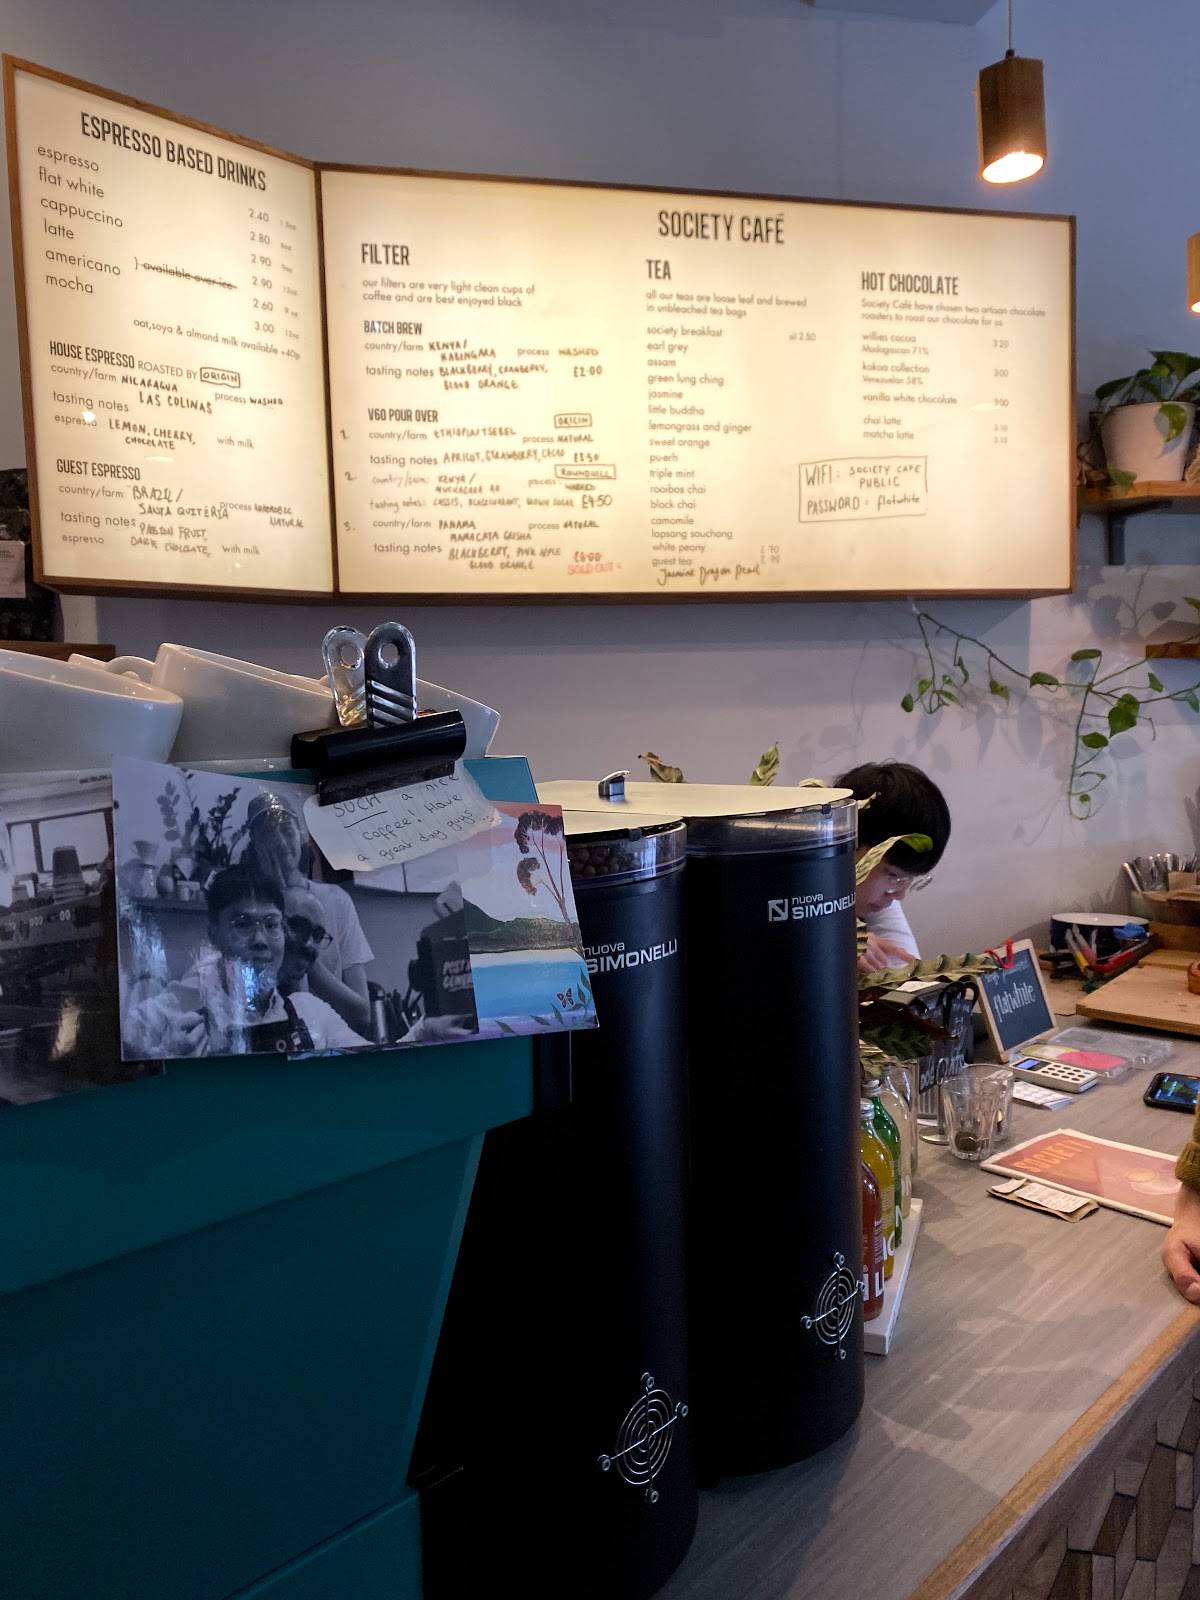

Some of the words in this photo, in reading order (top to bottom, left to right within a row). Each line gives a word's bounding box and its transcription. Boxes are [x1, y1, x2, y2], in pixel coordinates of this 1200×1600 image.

[81, 111, 161, 157] ESPRESSO
[166, 140, 213, 174] BASED
[218, 158, 266, 191] DRINKS
[37, 145, 99, 172] espresso
[39, 166, 61, 187] flat
[66, 174, 104, 198] white
[40, 197, 123, 228] cappuccino
[44, 218, 74, 239] latte
[658, 210, 734, 241] SOCIETY
[741, 213, 784, 244] CAFÉ
[361, 242, 410, 266] FILTER
[46, 249, 121, 276] americano
[646, 258, 671, 280] TEA
[143, 261, 192, 279] available
[46, 274, 93, 294] mocha
[362, 279, 378, 288] our
[381, 277, 406, 289] filters
[409, 282, 425, 291] are
[428, 282, 449, 295] very
[451, 279, 471, 294] light
[474, 282, 499, 293] clean
[502, 285, 523, 295] cups
[526, 284, 535, 295] of
[861, 271, 886, 291] HOT
[889, 273, 959, 296] CHOCOLATE
[362, 290, 392, 302] coffee
[395, 291, 413, 302] and
[417, 294, 432, 303] are
[436, 293, 454, 304] best
[457, 294, 495, 308] enjoyed
[498, 295, 522, 307] black
[756, 295, 773, 306] and
[776, 295, 807, 307] brewed
[657, 303, 707, 315] unbleached
[726, 305, 747, 319] bags
[1009, 305, 1046, 317] chocolate
[364, 319, 394, 334] BATCH
[397, 321, 422, 335] BREW
[647, 326, 678, 338] society
[681, 326, 723, 338] breakfast
[186, 327, 219, 343] almond
[221, 335, 238, 347] milk
[240, 338, 278, 355] available
[890, 334, 916, 343] cocoa
[364, 340, 424, 352] country/farm
[517, 348, 549, 357] process
[647, 340, 665, 351] earl
[668, 344, 688, 353] grey
[50, 341, 83, 360] HOUSE
[85, 347, 135, 369] ESPRESSO
[138, 360, 183, 378] ROASTED
[186, 369, 198, 380] BY
[202, 371, 238, 383] ORIGIN
[648, 358, 676, 367] assam
[891, 363, 930, 373] collection
[51, 363, 117, 383] country/farm
[366, 365, 402, 378] tasting
[406, 367, 434, 377] notes
[648, 375, 674, 385] green
[677, 372, 696, 386] lung
[699, 374, 725, 387] ching
[53, 391, 93, 410] tasting
[98, 399, 129, 412] notes
[215, 392, 246, 405] process
[648, 389, 683, 400] jasmine
[893, 393, 915, 402] white
[918, 393, 957, 404] chocolate
[139, 391, 161, 407] LAS
[168, 397, 212, 414] COLINAS
[368, 408, 386, 422] V60
[389, 409, 413, 422] POUR
[415, 410, 438, 423] OVER
[669, 405, 705, 416] buddha
[649, 420, 700, 433] lemongrass
[703, 421, 721, 432] and
[723, 423, 752, 434] ginger
[863, 429, 894, 439] matcha
[368, 428, 427, 441] country/farm
[522, 435, 554, 444] process
[217, 436, 235, 446] with
[238, 438, 254, 449] milk
[649, 438, 675, 447] sweet
[677, 440, 710, 449] orange
[370, 454, 406, 468] tasting
[410, 456, 438, 466] notes
[57, 459, 88, 476] GUEST
[92, 462, 141, 481] ESPRESSO
[650, 469, 673, 480] triple
[676, 469, 695, 479] mint
[849, 465, 890, 476] SOCIETY
[896, 464, 921, 474] CAFE
[650, 485, 684, 494] rooibos
[687, 485, 706, 494] chai
[859, 476, 900, 489] PUBLIC
[58, 484, 124, 500] country/farm
[220, 501, 252, 512] process
[650, 499, 673, 509] black
[677, 499, 696, 509] chai
[877, 494, 920, 512] flatwhite
[61, 512, 100, 527] tasting
[105, 515, 136, 527] notes
[373, 518, 431, 530] country/farm
[438, 519, 476, 530] PANAMA
[528, 522, 559, 531] process
[651, 516, 694, 526] camomile
[62, 533, 104, 546] espresso
[651, 529, 687, 540] lapsang
[690, 529, 733, 540] souchong
[222, 545, 241, 554] with
[243, 545, 260, 555] milk
[374, 542, 410, 555] tasting
[414, 542, 442, 553] notes
[653, 543, 675, 551] white
[678, 543, 705, 554] peony
[652, 557, 677, 568] guest
[679, 558, 692, 566] tea
[657, 568, 695, 586] Jasmine
[700, 565, 731, 585] Dragon
[334, 793, 382, 818] SUCH
[401, 793, 414, 801] a
[423, 793, 463, 815] Have
[357, 853, 370, 862] a
[378, 840, 414, 861] great
[419, 829, 448, 843] day
[447, 808, 475, 832] guys
[792, 892, 824, 904] nuova
[791, 891, 856, 920] SIMONELLI
[582, 942, 625, 956] nuova
[585, 938, 678, 975] SIMONELLI
[993, 981, 1037, 1023] flatwhite
